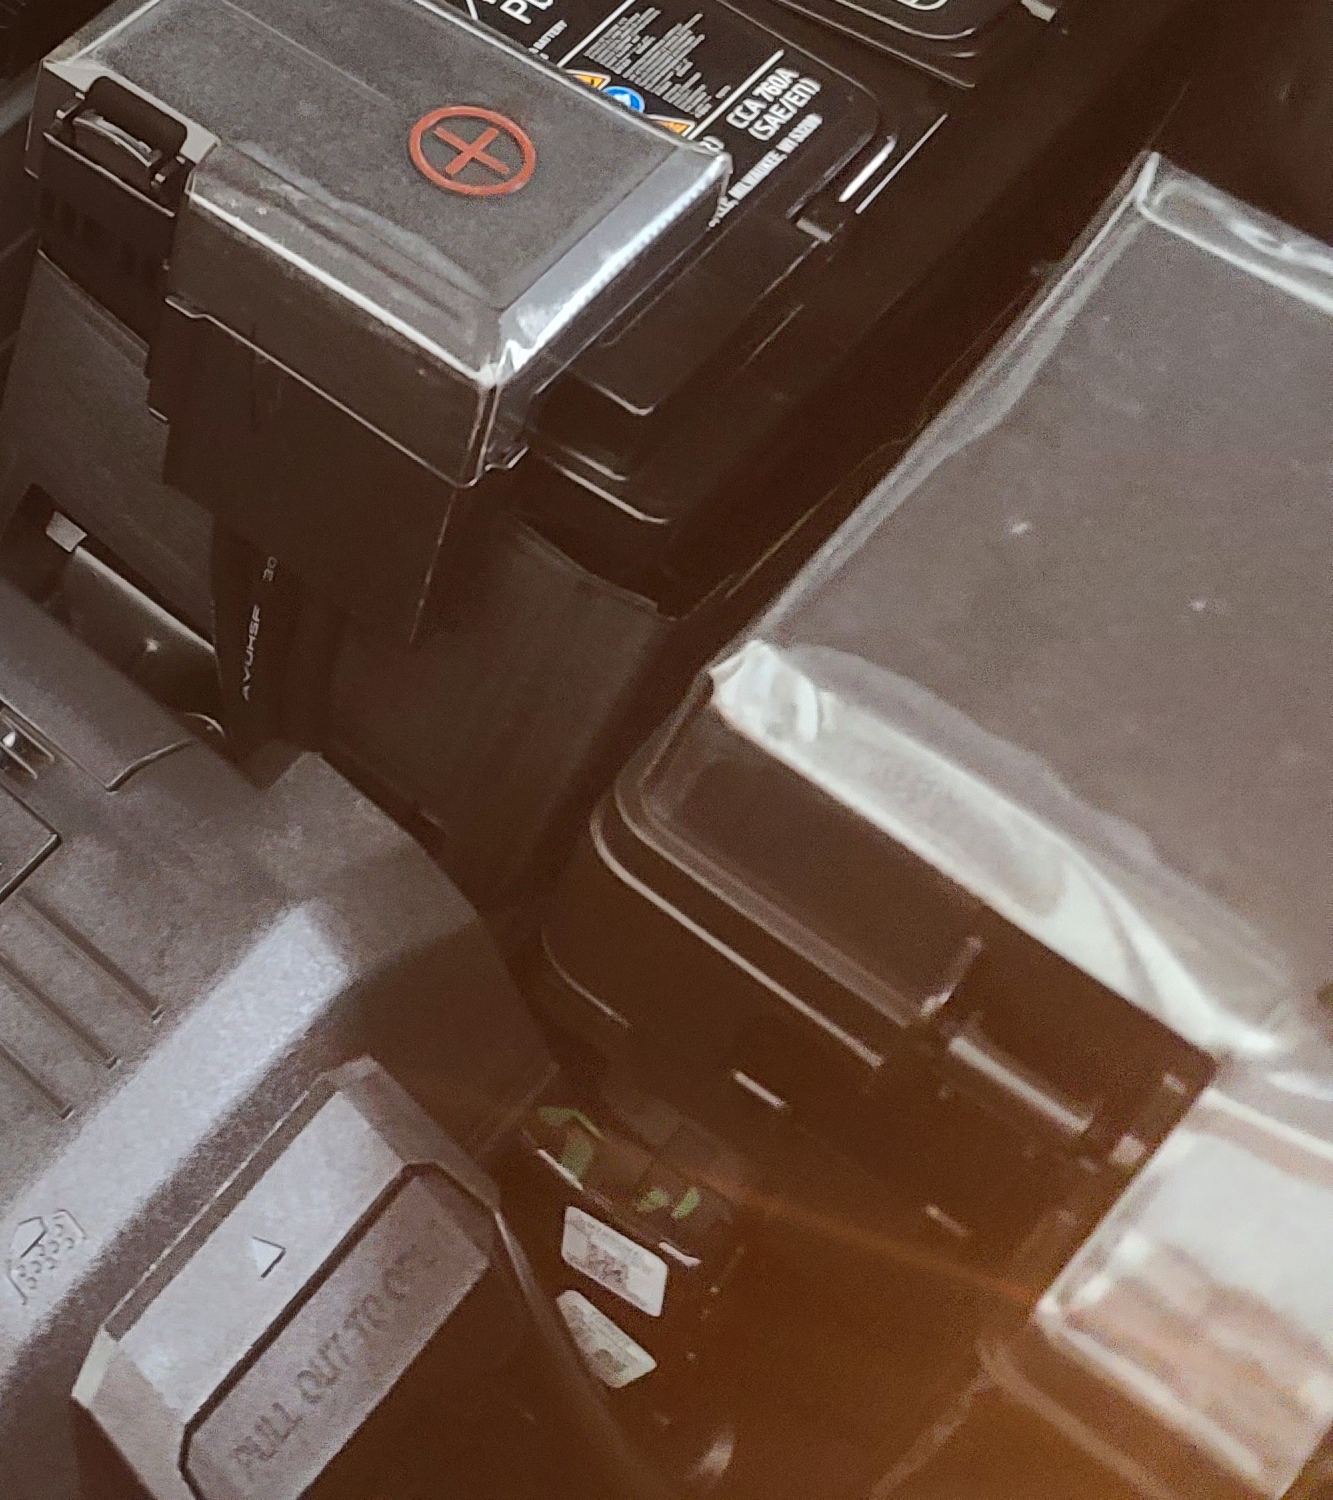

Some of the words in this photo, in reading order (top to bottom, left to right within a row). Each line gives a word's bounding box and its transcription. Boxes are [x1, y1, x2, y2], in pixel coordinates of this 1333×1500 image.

[726, 98, 768, 129] CCA
[752, 67, 800, 101] 760A
[296, 1332, 352, 1404] OUT
